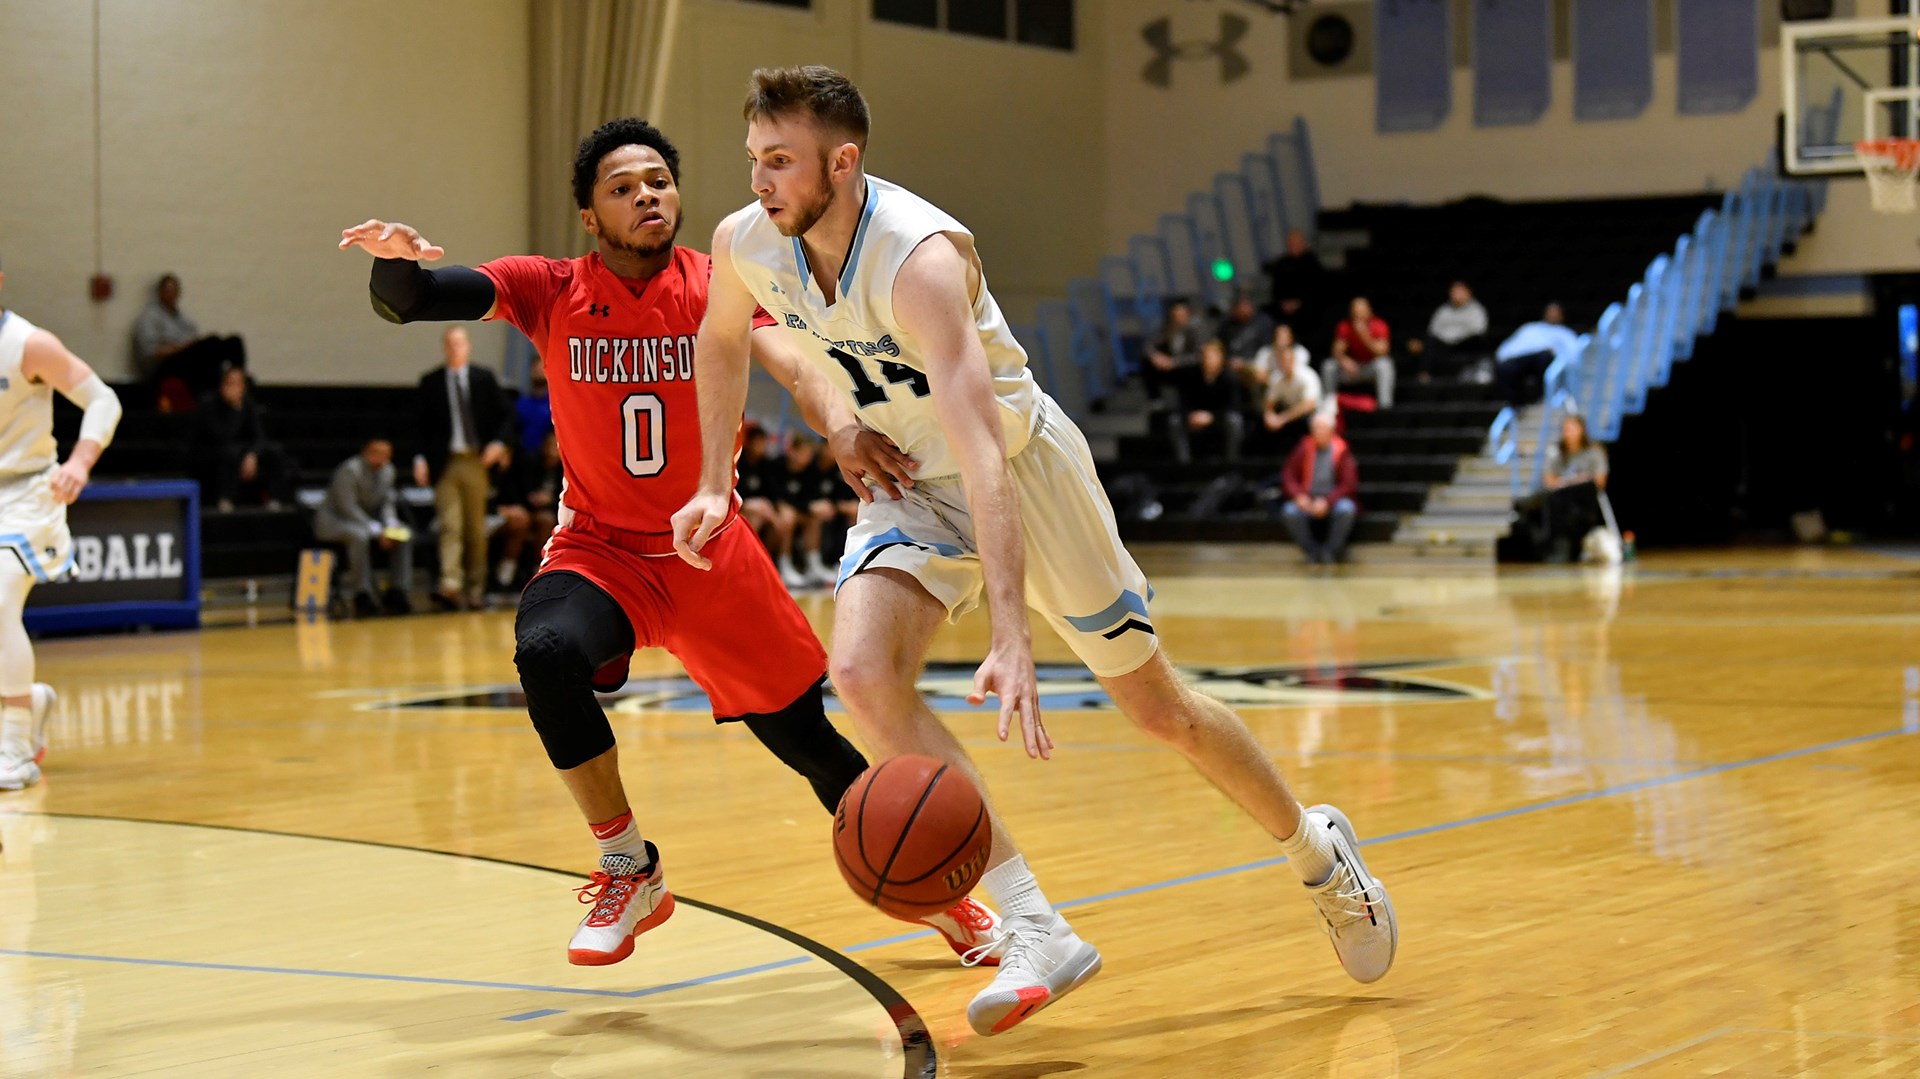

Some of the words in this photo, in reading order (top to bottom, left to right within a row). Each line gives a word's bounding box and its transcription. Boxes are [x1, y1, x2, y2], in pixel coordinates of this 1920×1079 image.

[568, 335, 697, 383] DICKINSO
[825, 345, 931, 409] 14
[620, 392, 667, 478] 0
[72, 532, 183, 582] BALL
